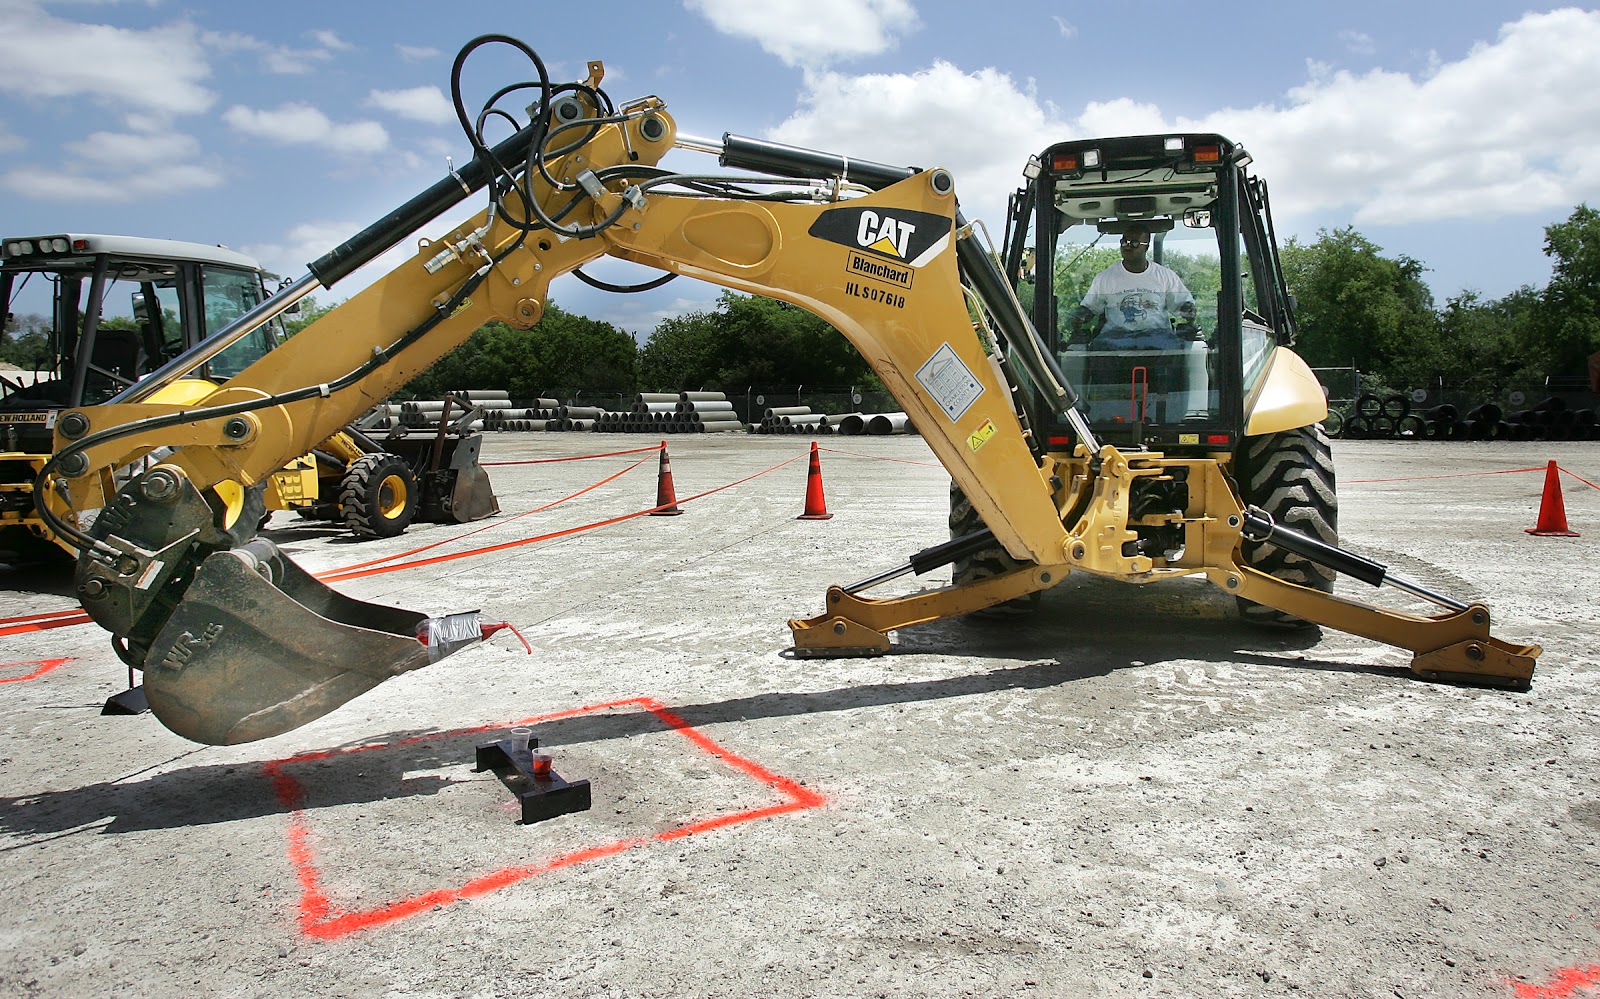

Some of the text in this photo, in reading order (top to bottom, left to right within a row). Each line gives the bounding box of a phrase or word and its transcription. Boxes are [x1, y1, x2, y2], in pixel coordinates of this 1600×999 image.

[857, 210, 916, 259] CAT
[852, 256, 909, 284] Blanchard
[12, 414, 47, 422] HOLLAND
